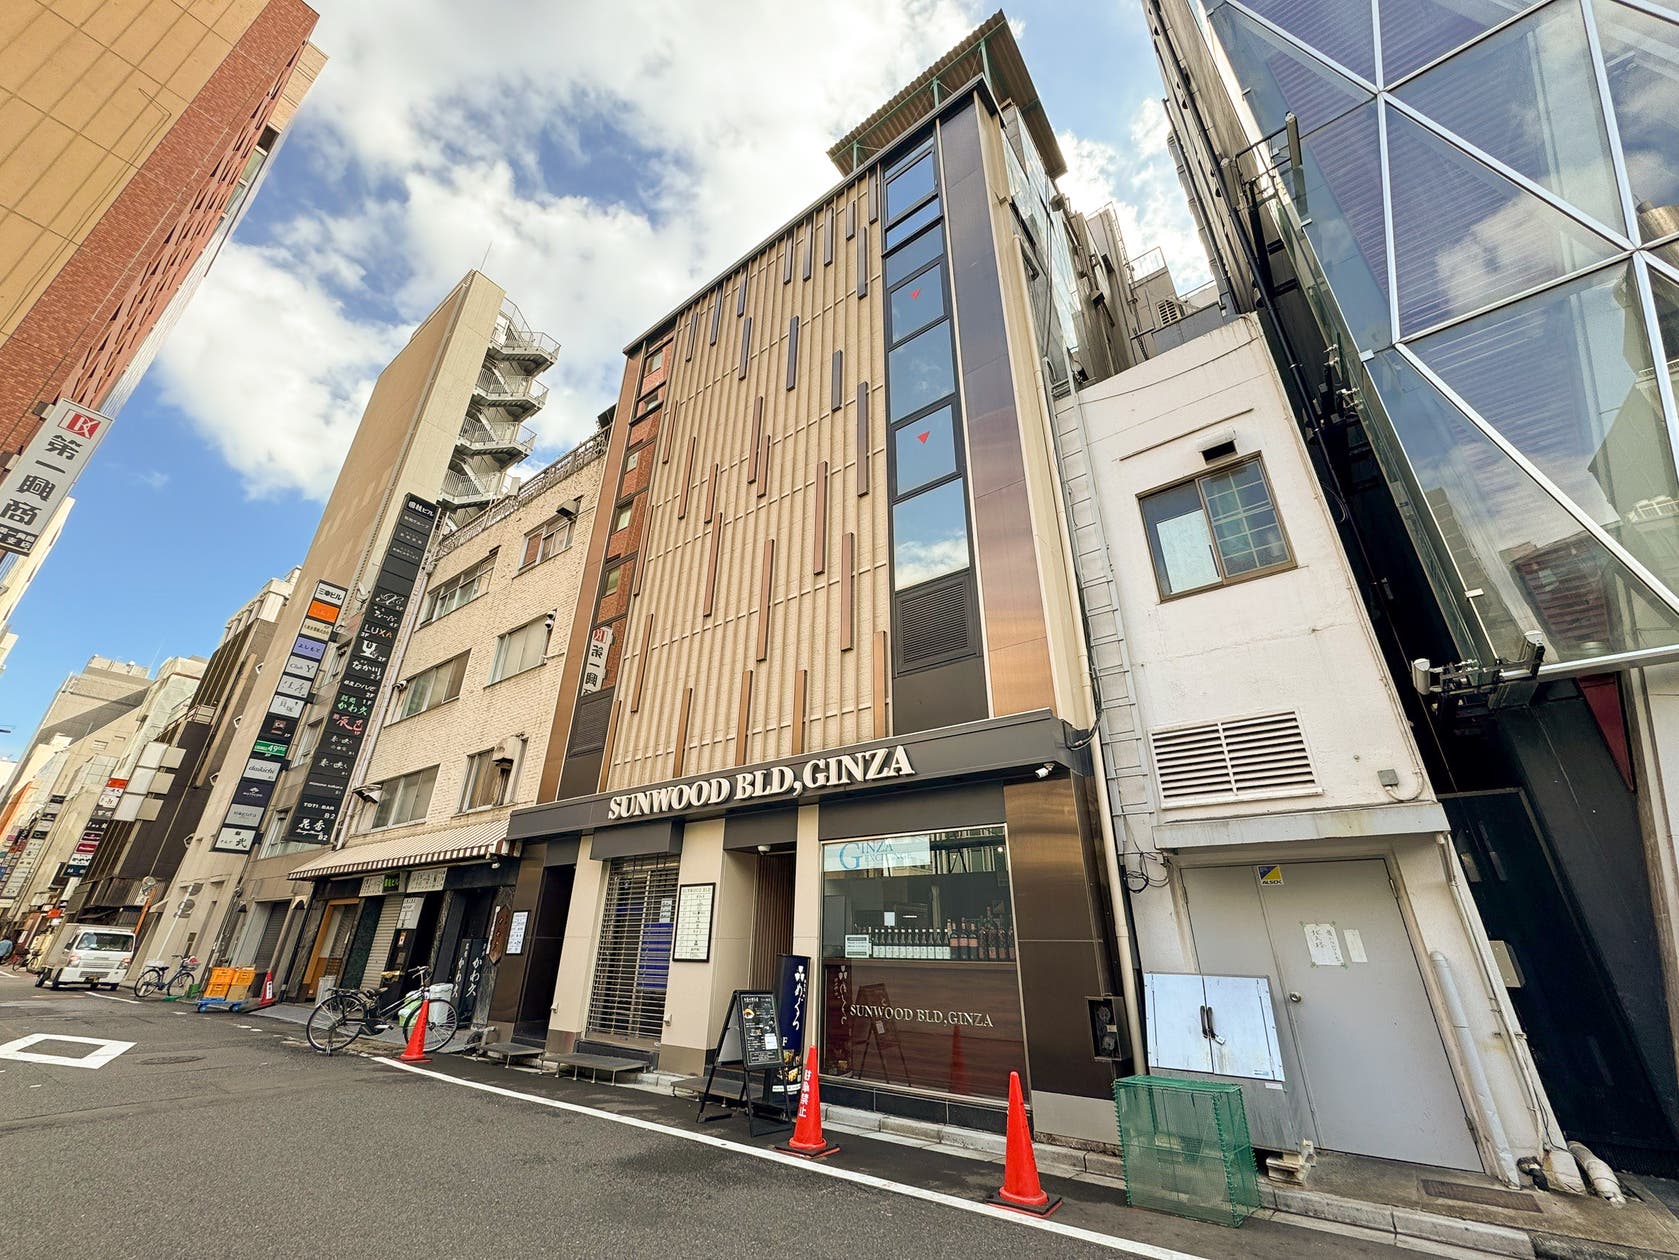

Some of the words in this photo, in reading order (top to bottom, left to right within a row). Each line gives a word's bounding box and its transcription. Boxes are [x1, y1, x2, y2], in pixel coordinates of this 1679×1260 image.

[0, 434, 83, 525] 第一興商
[305, 664, 315, 673] Y
[608, 778, 731, 819] SUNWOOD
[466, 957, 482, 997] かわ久
[850, 1004, 913, 1021] SUNWOOD
